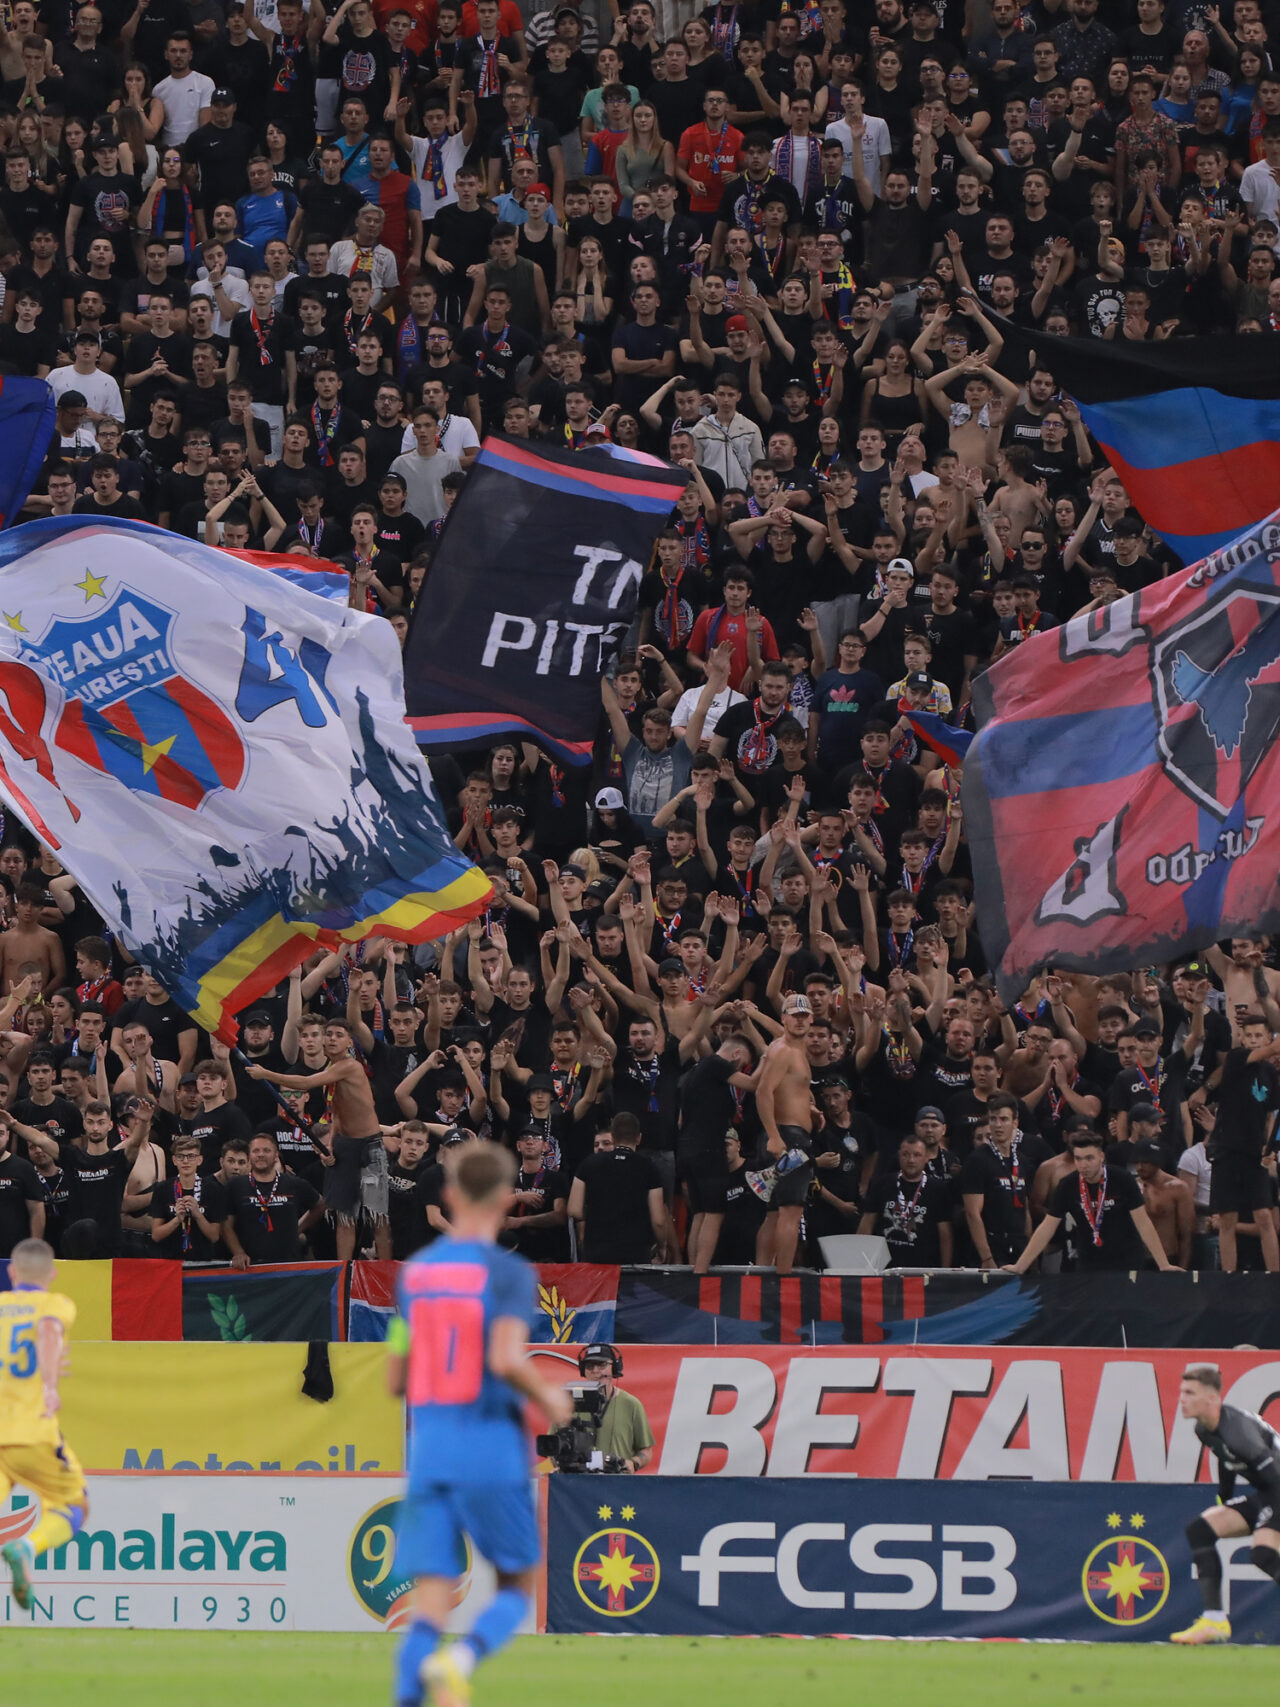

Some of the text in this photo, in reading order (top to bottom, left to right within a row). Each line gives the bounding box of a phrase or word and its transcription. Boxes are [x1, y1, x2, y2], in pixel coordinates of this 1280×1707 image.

[77, 1168, 108, 1178] TORNADO
[726, 1186, 744, 1196] NADO
[912, 1205, 927, 1215] 96
[279, 1496, 296, 1506] TM
[681, 1521, 1018, 1612] FCSB
[385, 1580, 412, 1602] YEARS
[172, 1596, 288, 1622] 1930
